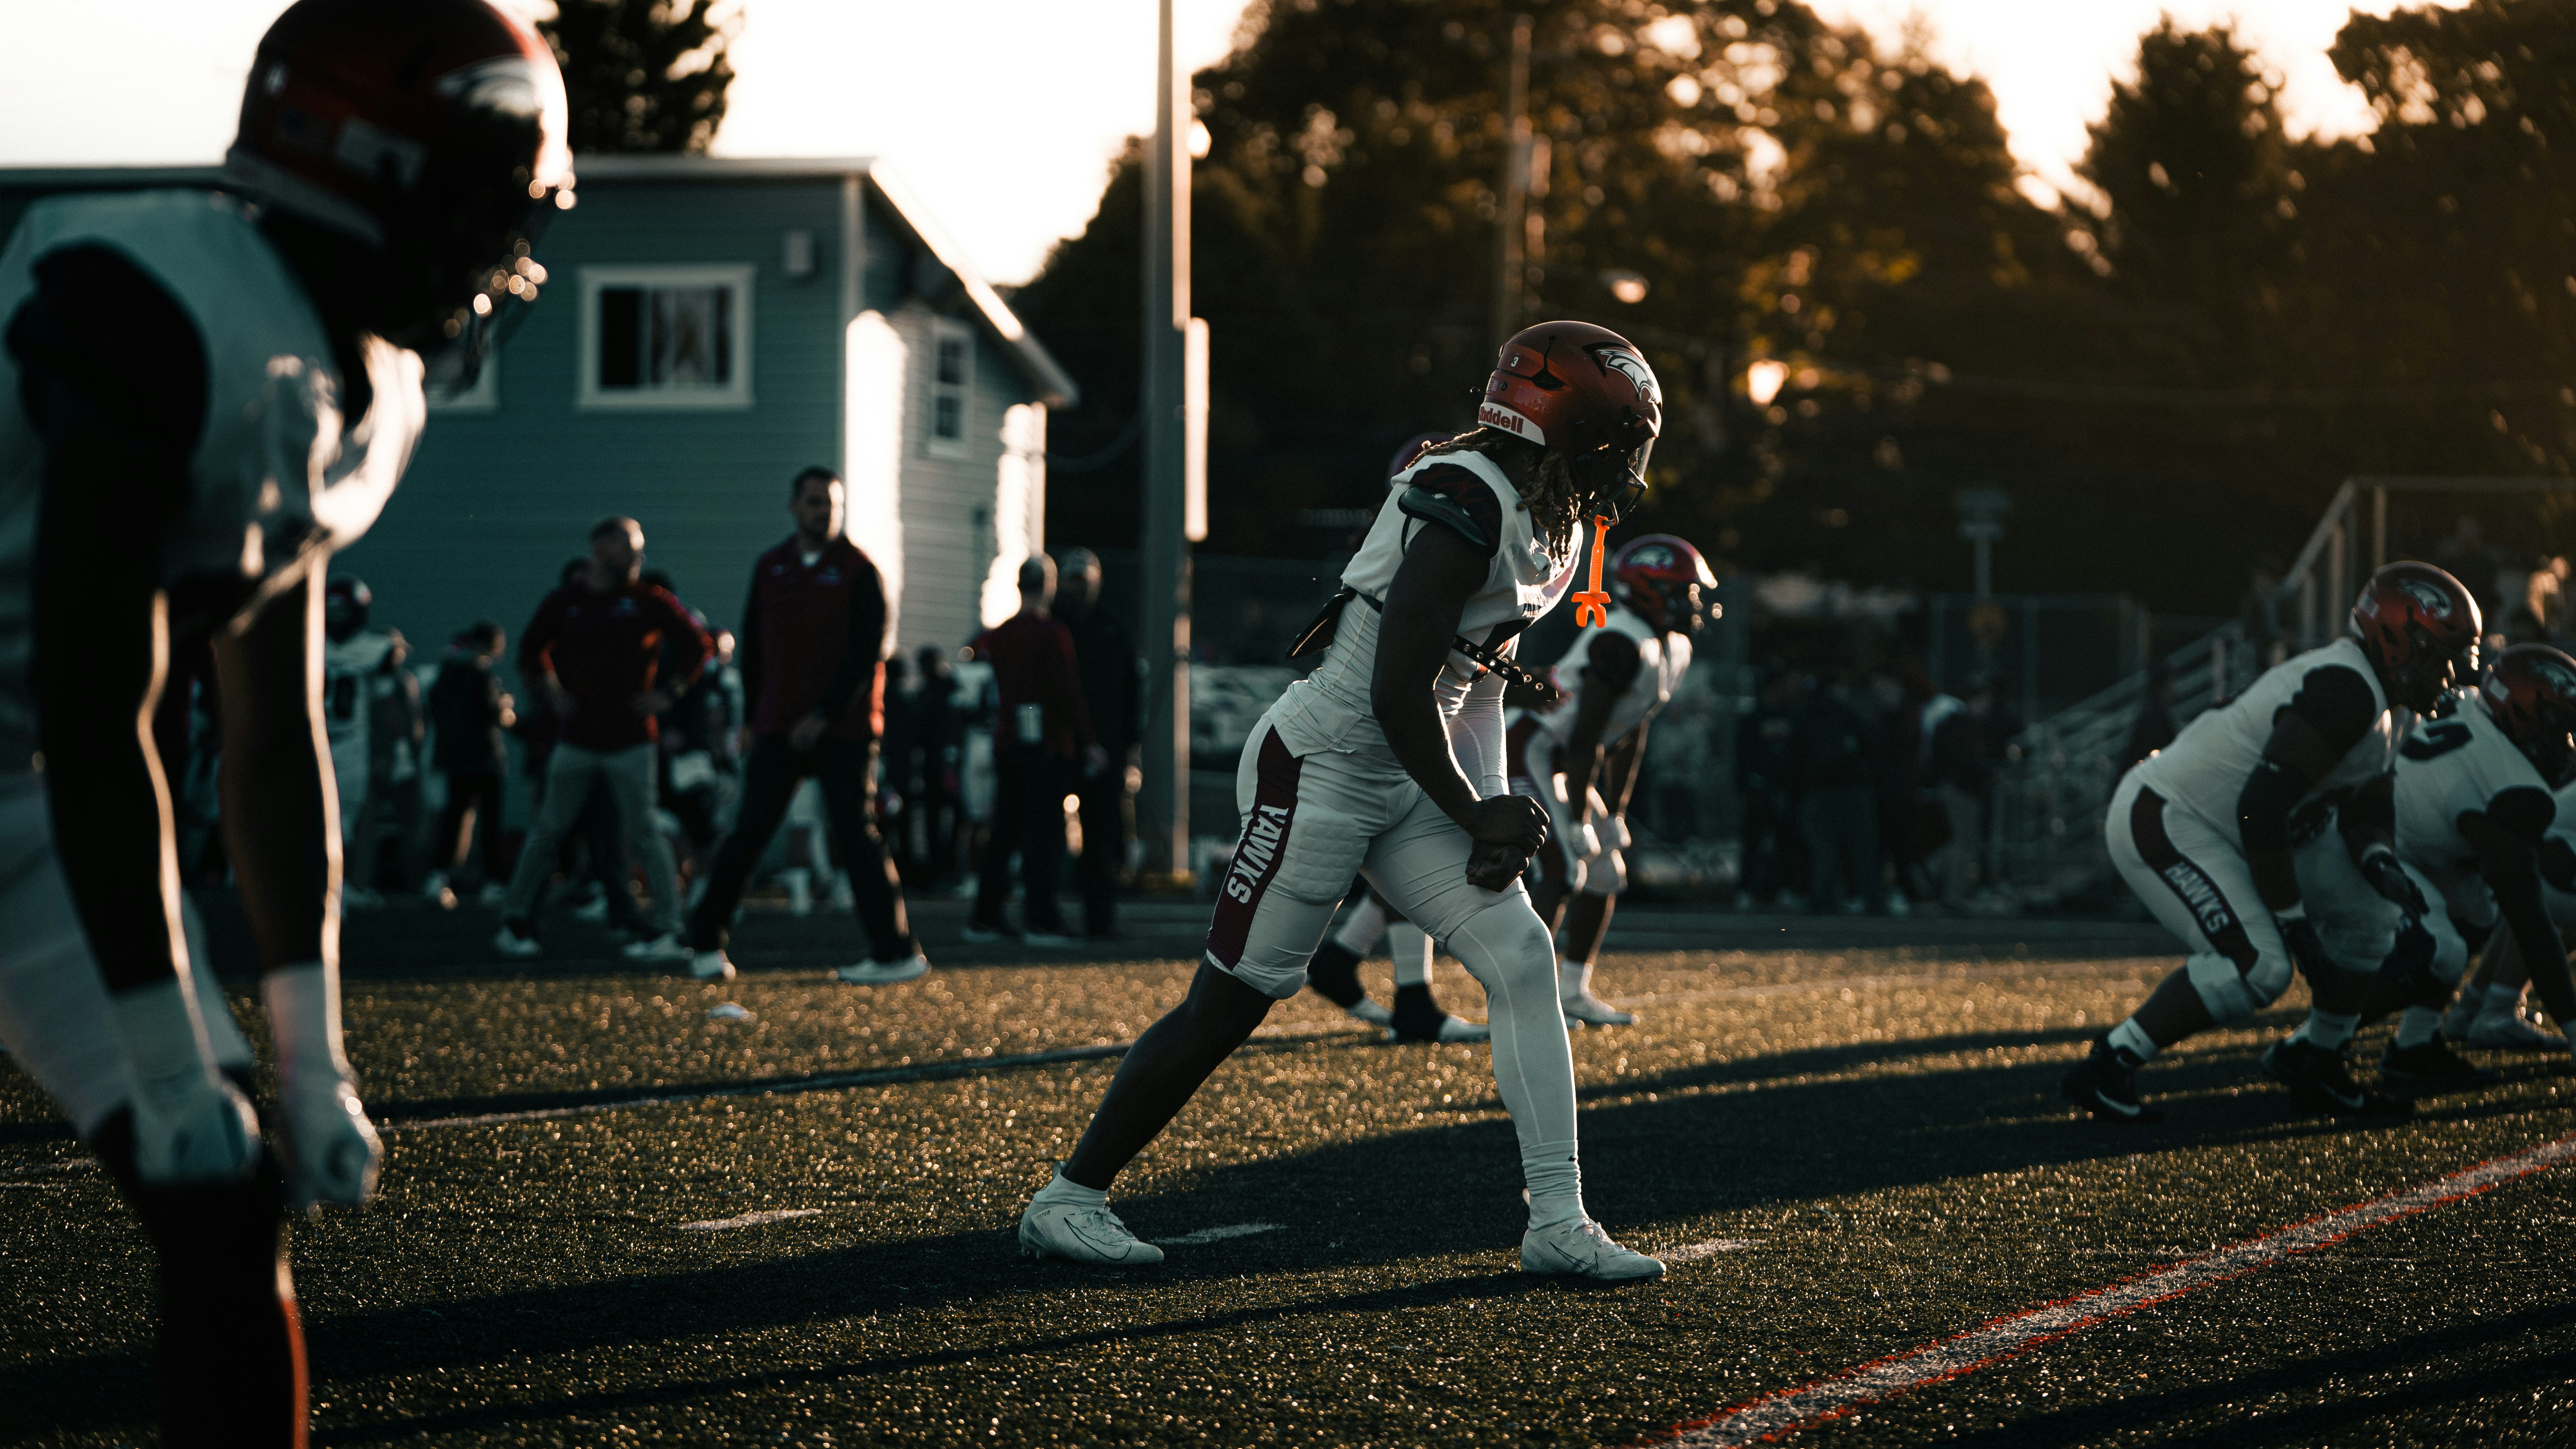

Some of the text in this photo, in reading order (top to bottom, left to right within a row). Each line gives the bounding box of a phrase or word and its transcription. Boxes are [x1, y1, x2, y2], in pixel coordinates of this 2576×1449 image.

[1510, 356, 1519, 367] 3
[1227, 804, 1289, 904] HAWKS
[2163, 861, 2231, 934] HAWKS
[1037, 1209, 1051, 1219] VAPOR
